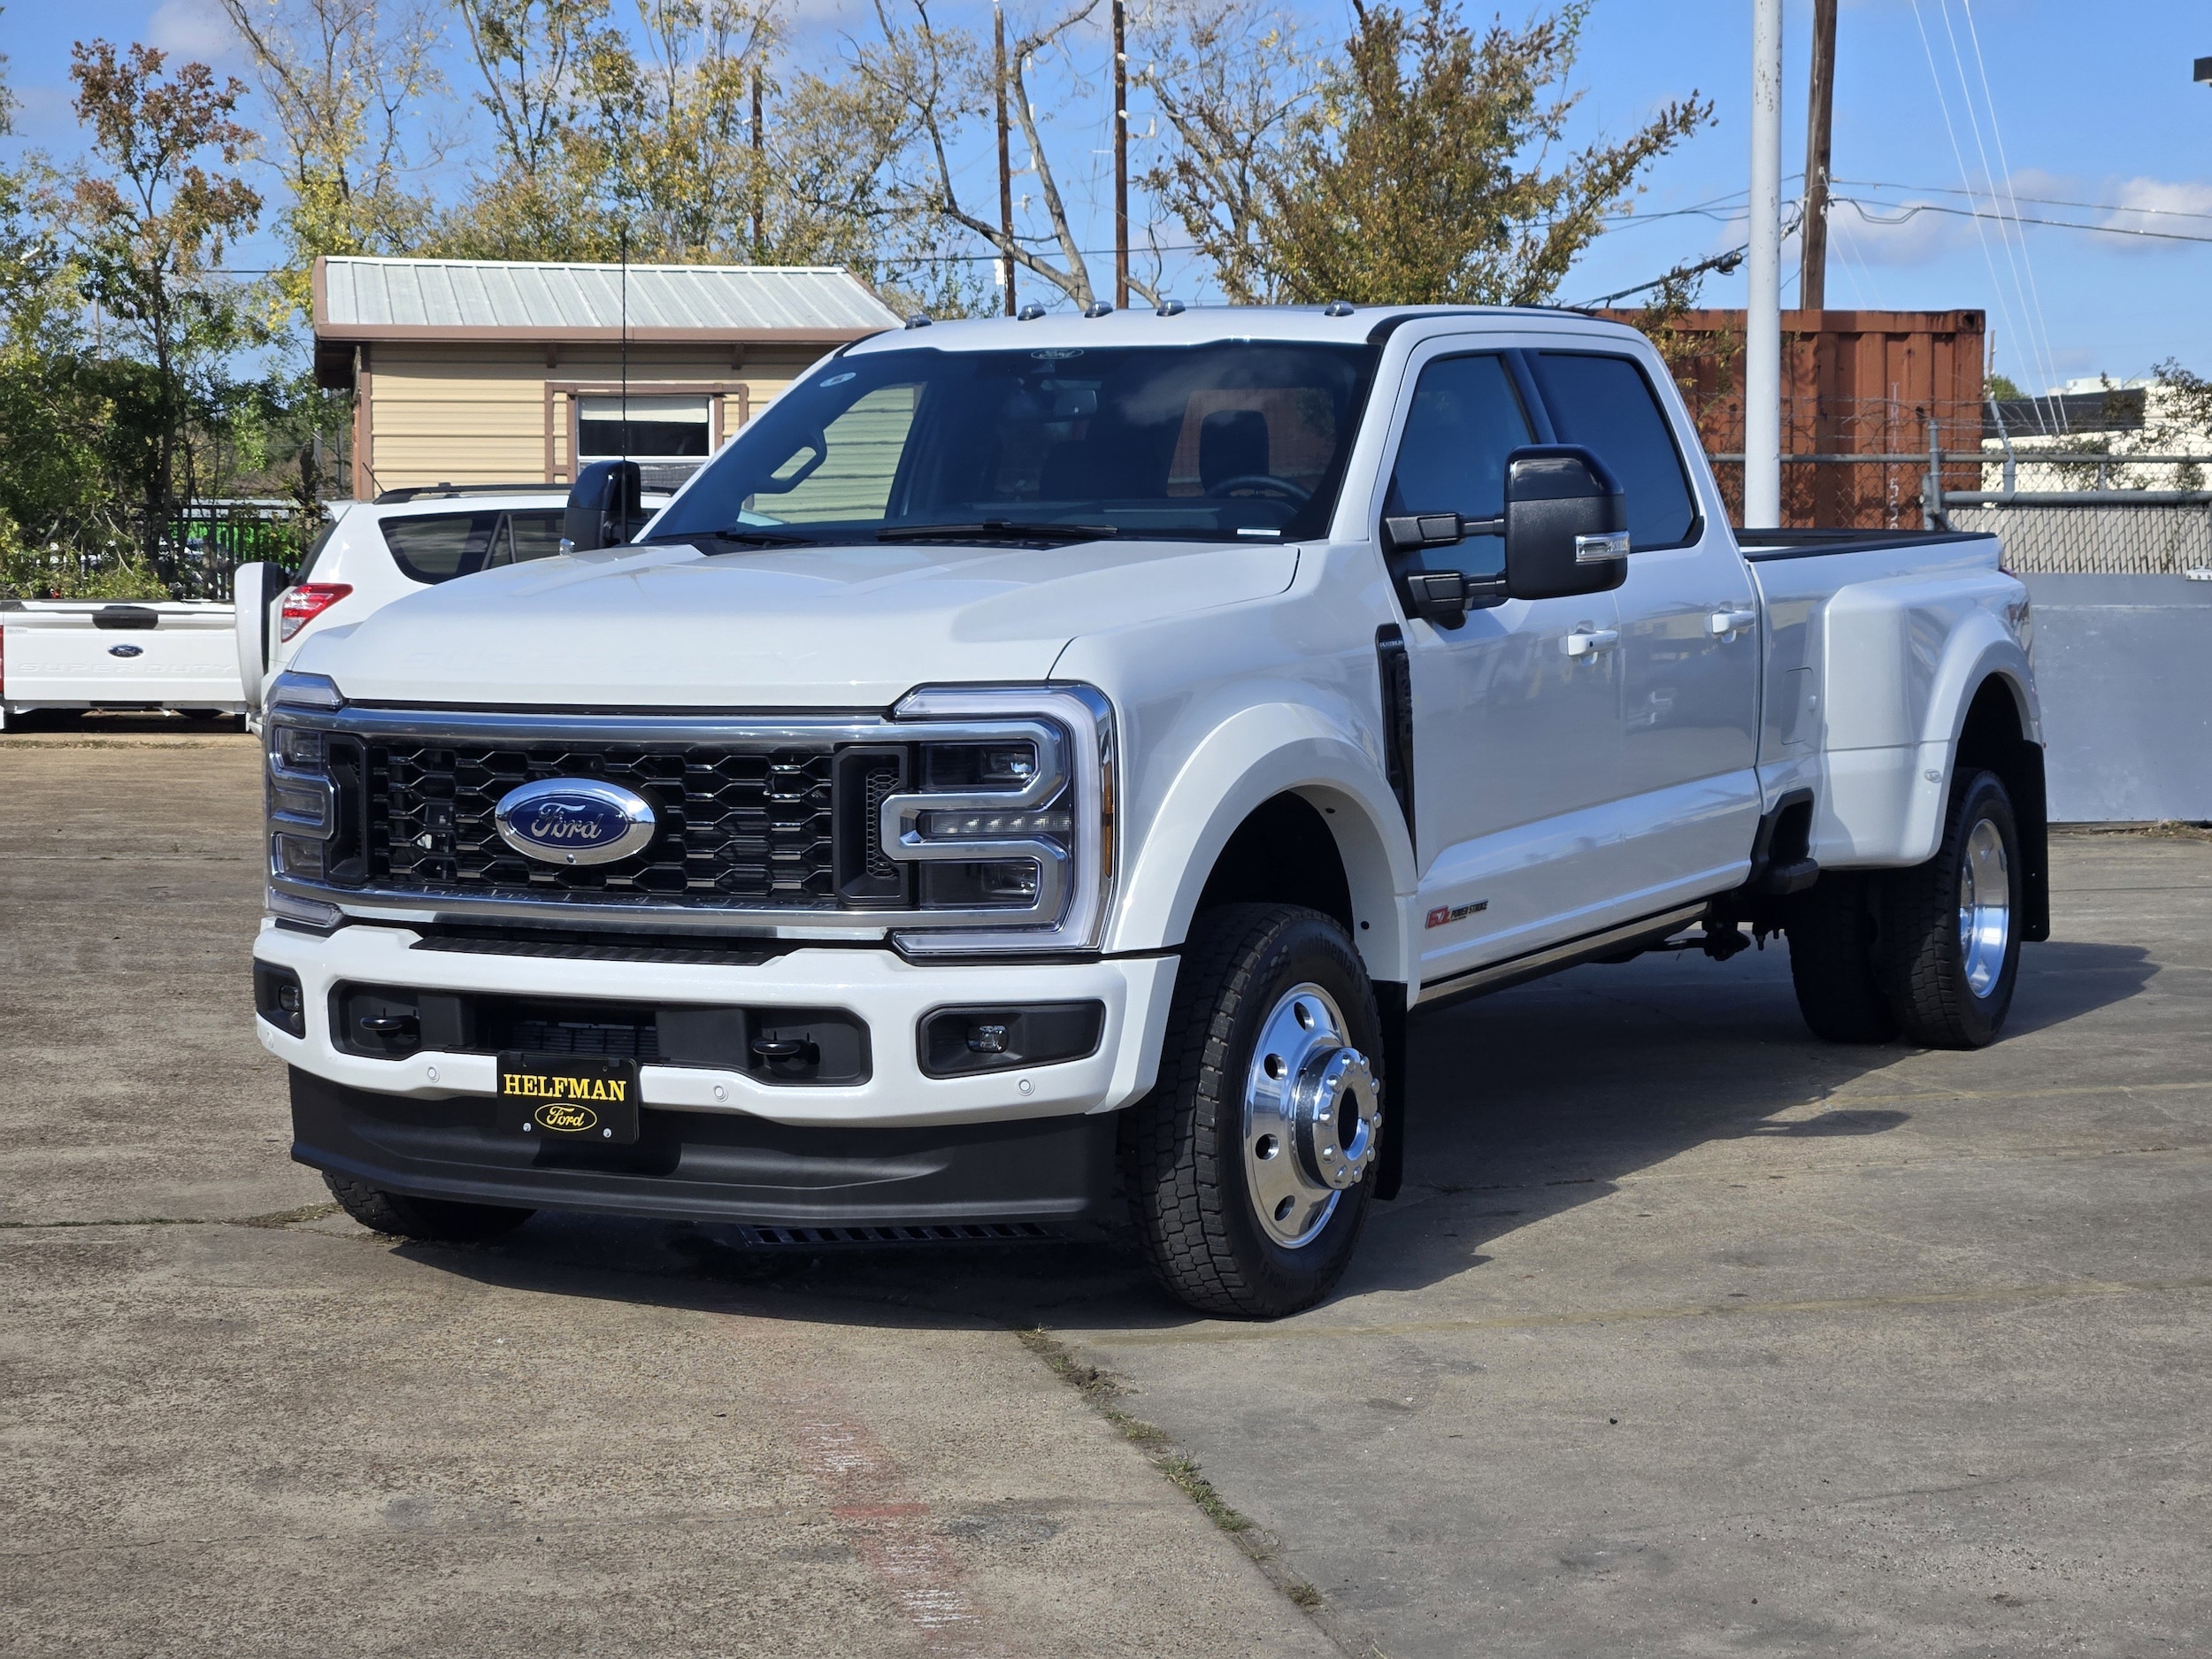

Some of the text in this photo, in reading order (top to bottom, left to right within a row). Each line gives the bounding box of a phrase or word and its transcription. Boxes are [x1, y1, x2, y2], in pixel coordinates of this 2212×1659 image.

[19, 662, 234, 674] SUPER DUTY
[531, 803, 604, 840] Ford
[503, 1073, 626, 1102] HELFMAN
[546, 1106, 585, 1126] Ford
